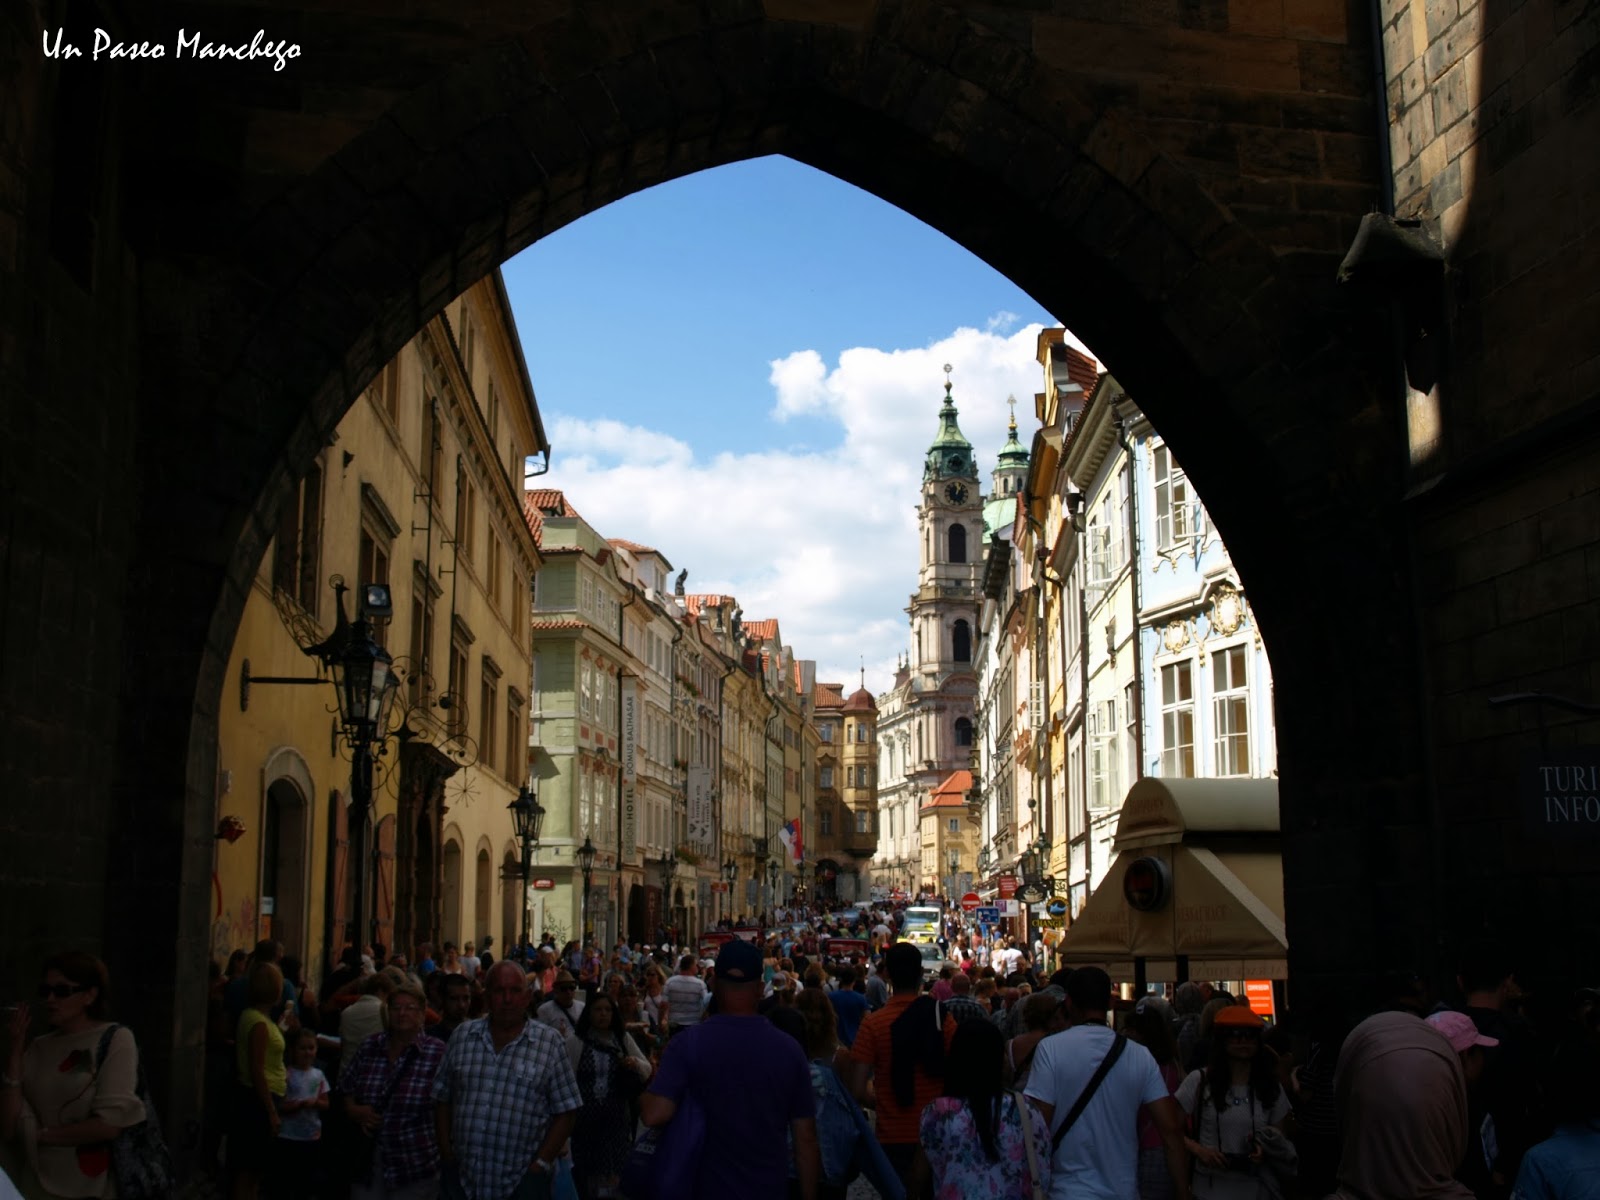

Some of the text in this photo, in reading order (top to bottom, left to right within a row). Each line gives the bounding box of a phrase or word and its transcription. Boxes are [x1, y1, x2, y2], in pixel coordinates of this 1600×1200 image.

[626, 696, 634, 856] DESIGN HOTEL DOMUS BALTHASAR
[1539, 765, 1600, 792] TURI
